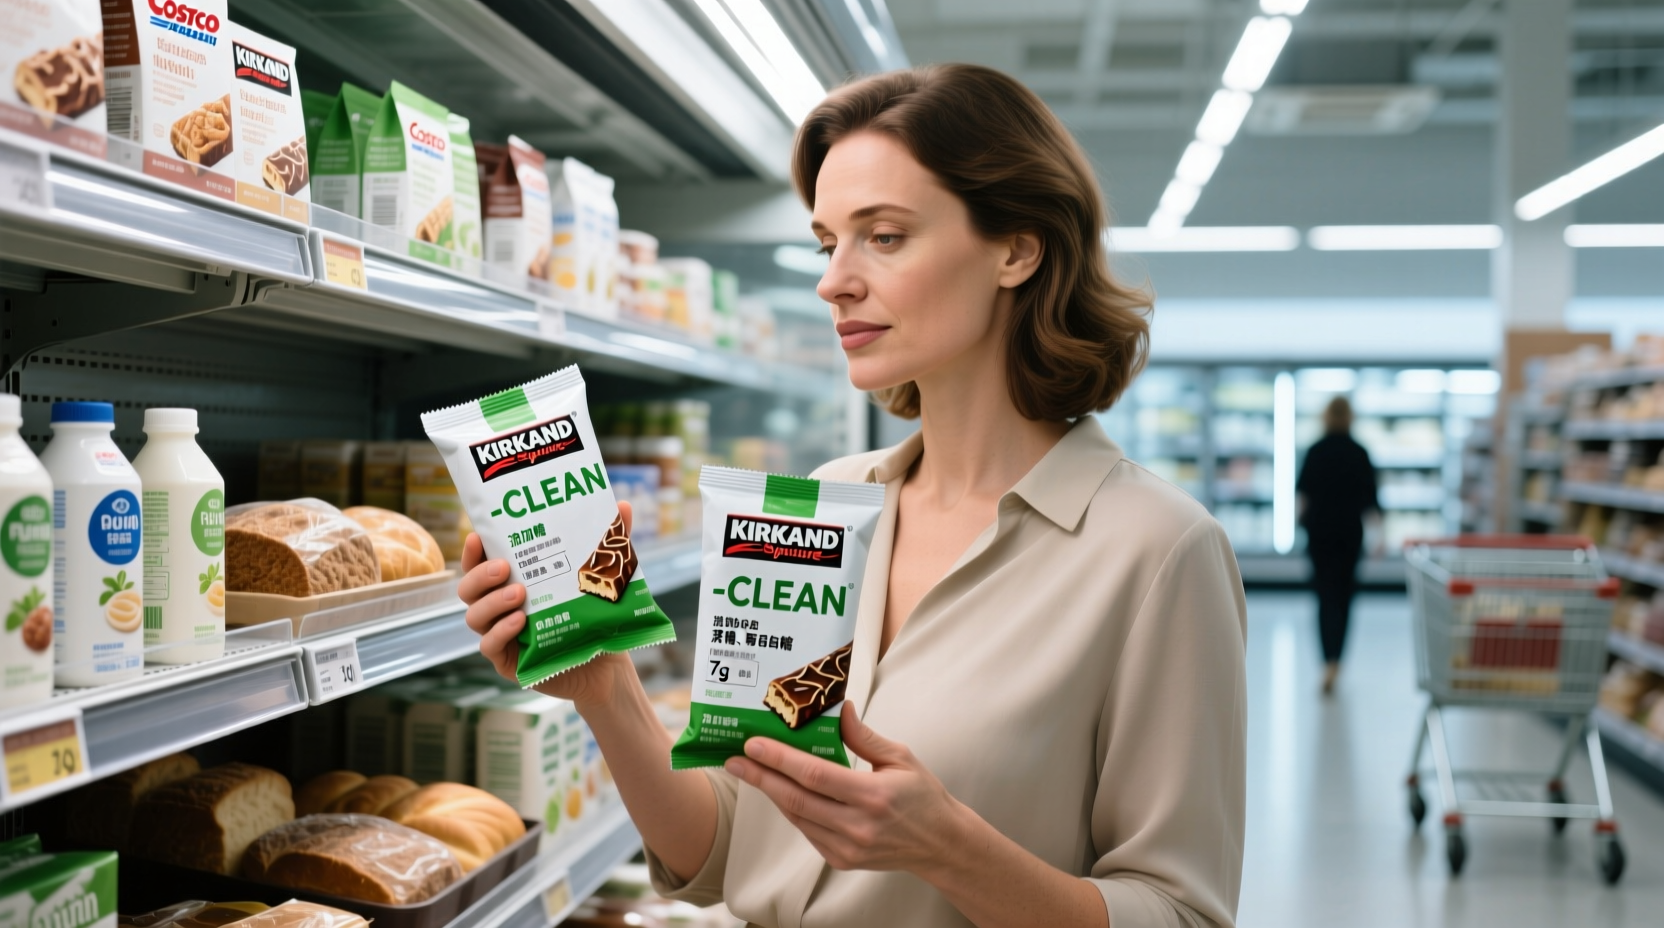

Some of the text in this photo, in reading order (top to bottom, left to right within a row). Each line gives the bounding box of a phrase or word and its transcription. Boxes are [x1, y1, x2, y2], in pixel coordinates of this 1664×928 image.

[476, 420, 573, 465] KIRKAND
[730, 519, 840, 550] KIRKAND
[709, 659, 730, 682] 7g
